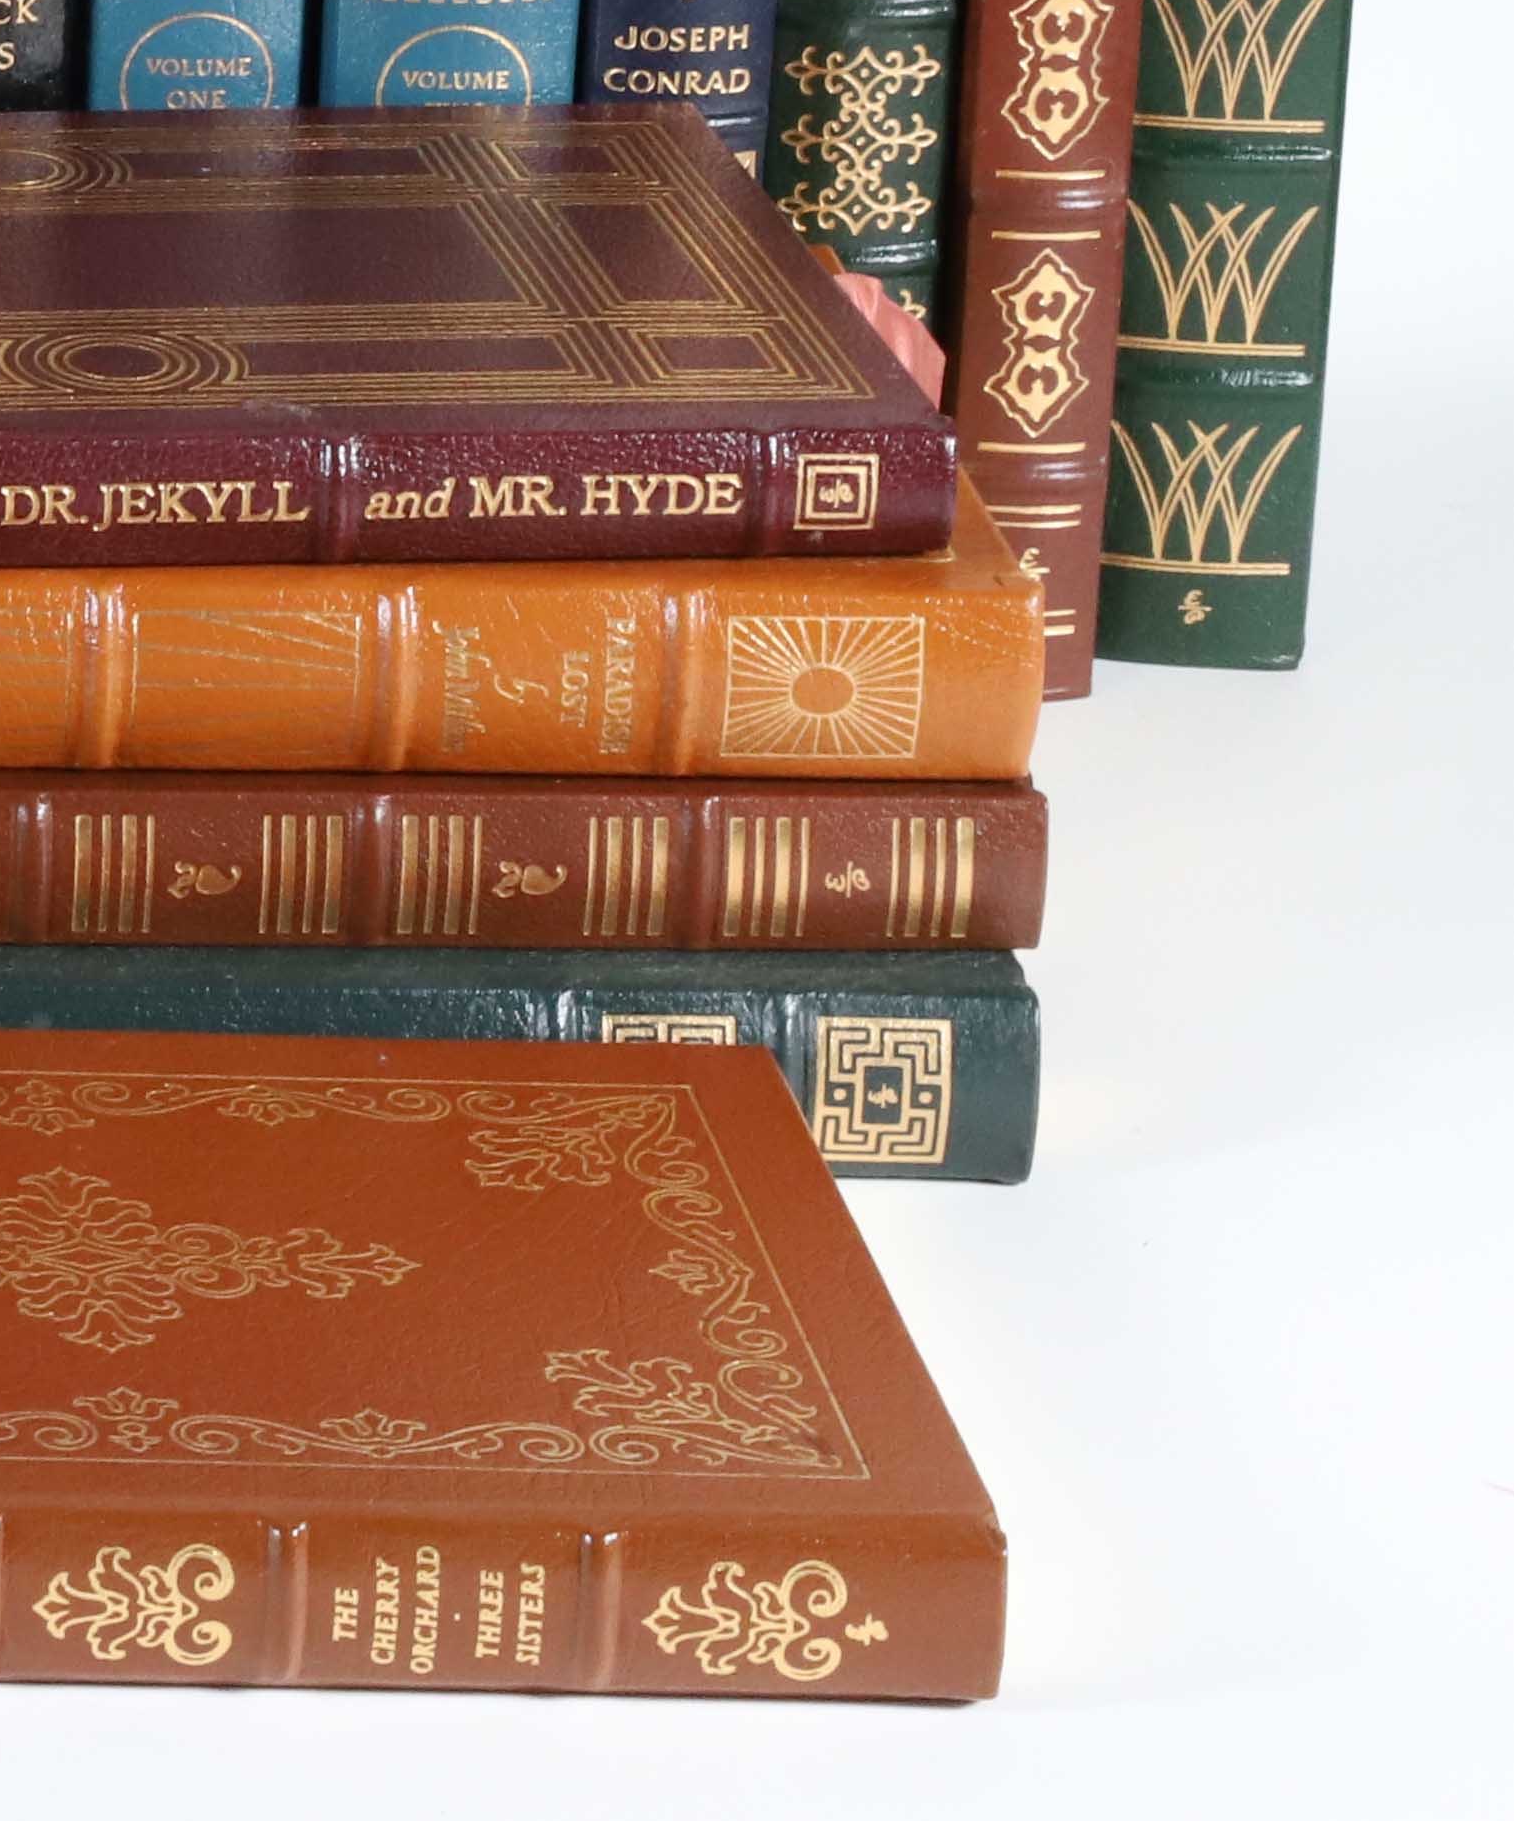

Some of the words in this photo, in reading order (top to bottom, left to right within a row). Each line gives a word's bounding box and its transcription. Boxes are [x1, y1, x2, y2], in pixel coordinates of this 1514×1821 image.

[144, 56, 252, 78] VOLUME
[612, 24, 750, 54] JOSEPH
[400, 69, 511, 92] VOLUME
[601, 66, 752, 96] CONRAD
[93, 481, 315, 532] JEKYLL
[579, 471, 745, 518] HYDE
[560, 649, 591, 729] LOST
[331, 1584, 359, 1643] THE
[369, 1555, 401, 1667] CHERRY
[409, 1544, 442, 1676] ORCHARD
[473, 1568, 506, 1661] THREE
[514, 1561, 547, 1667] SISTERS
